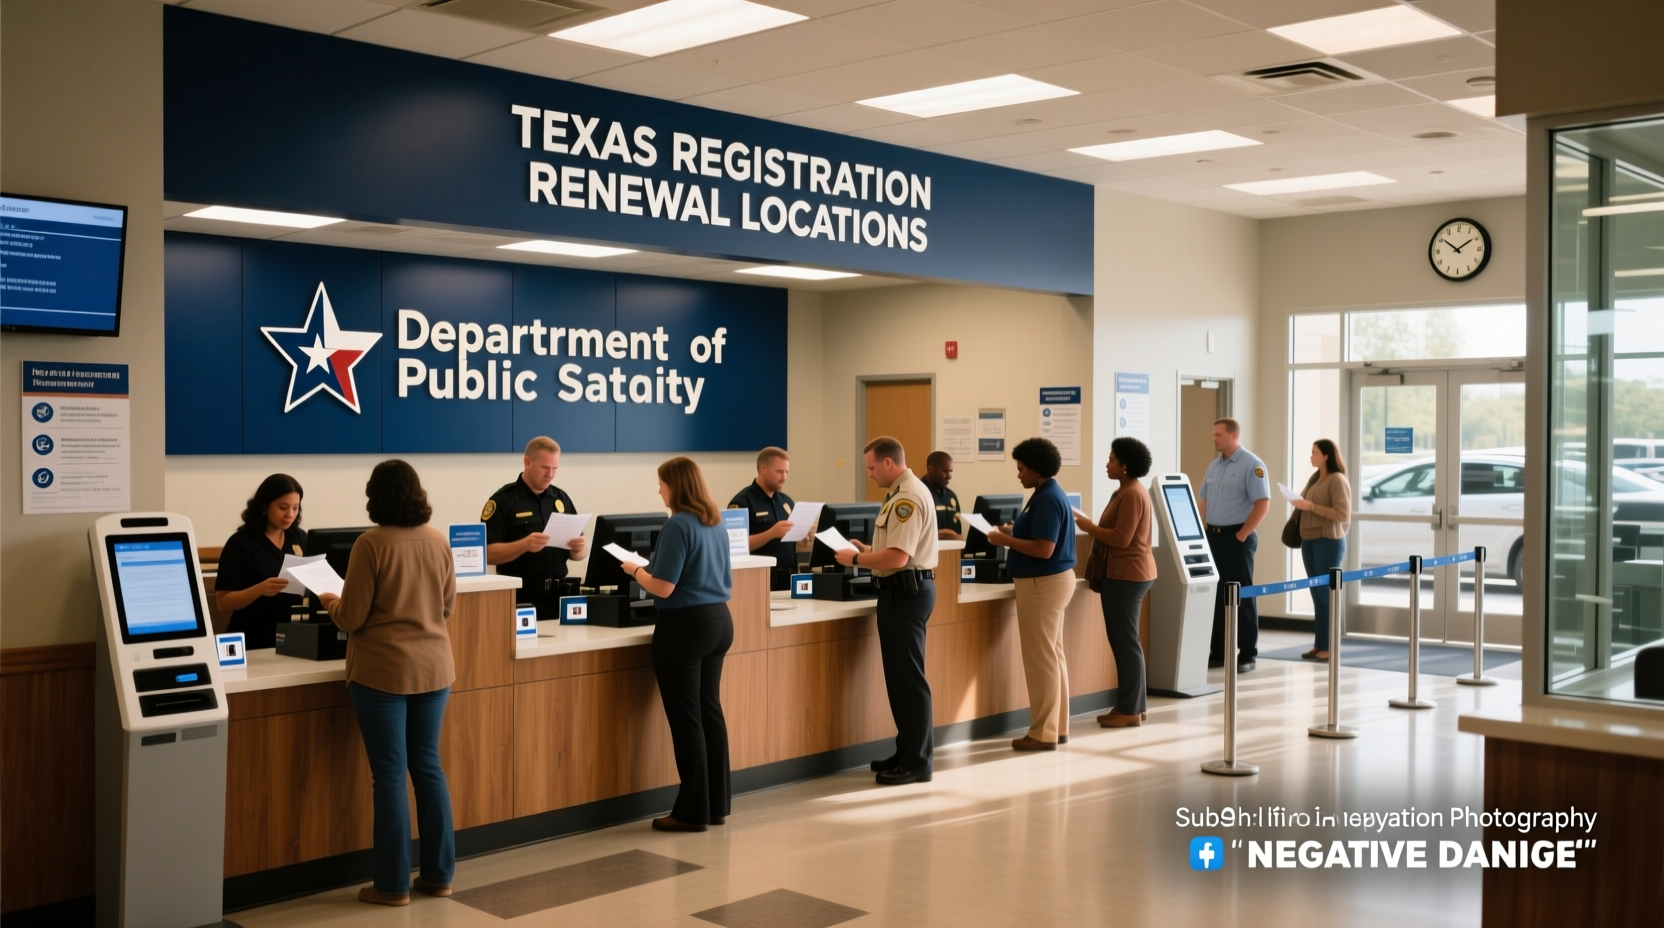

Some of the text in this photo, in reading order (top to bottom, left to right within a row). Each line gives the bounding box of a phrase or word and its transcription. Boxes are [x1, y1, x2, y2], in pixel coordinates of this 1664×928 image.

[511, 104, 931, 211] TEXAS REGISTRATION
[529, 161, 928, 253] RENEWAL LOCATIONS
[398, 357, 538, 402] Public
[690, 327, 727, 364] of
